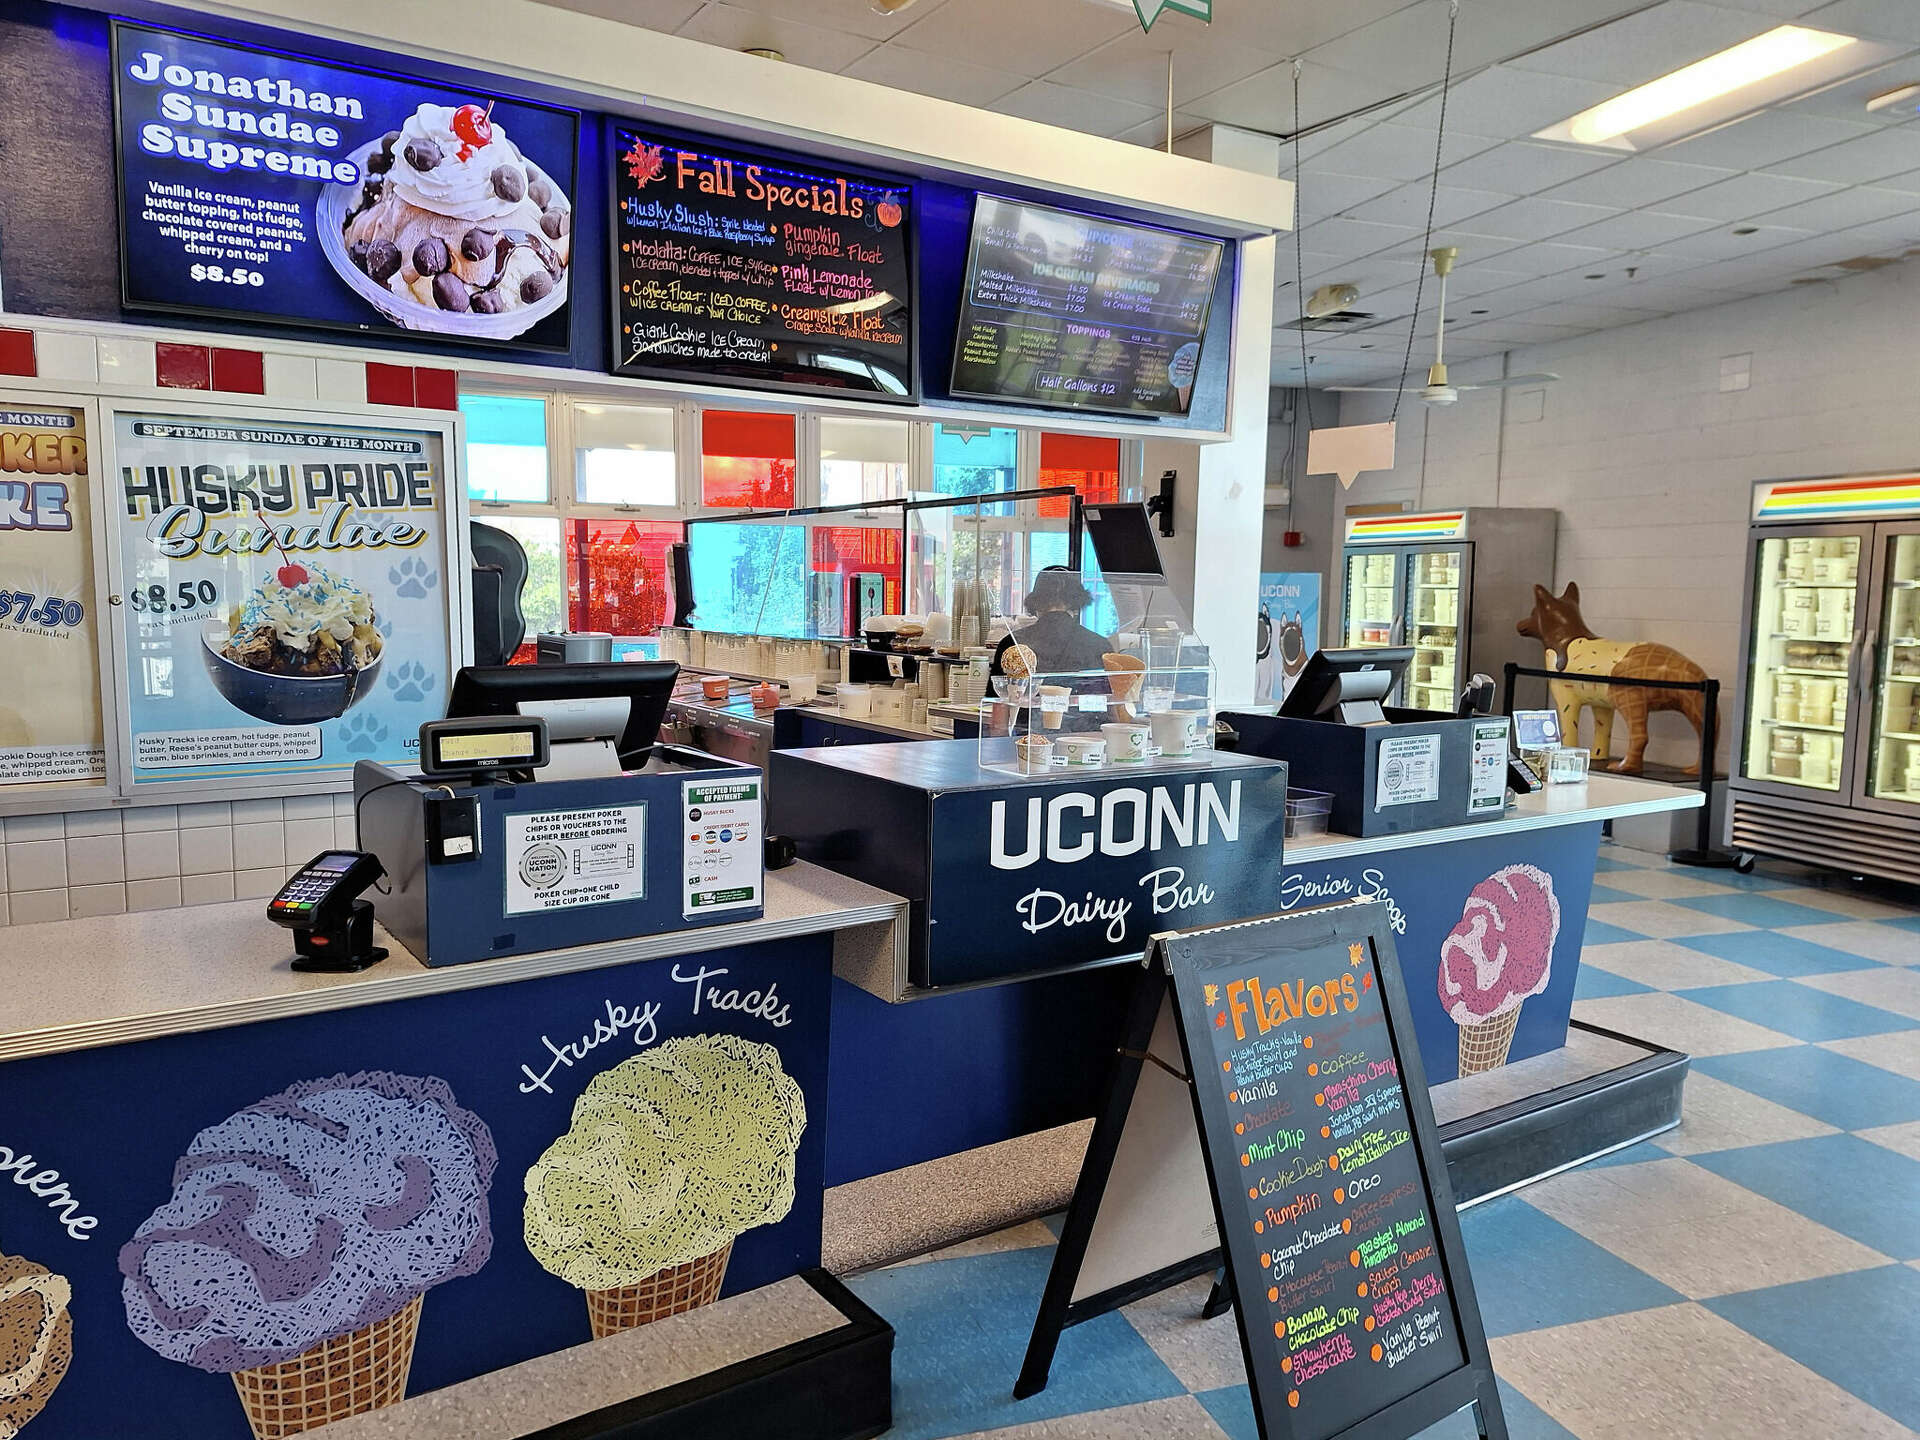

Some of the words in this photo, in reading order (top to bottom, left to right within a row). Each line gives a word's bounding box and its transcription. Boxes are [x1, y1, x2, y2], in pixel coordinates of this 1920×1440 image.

[130, 52, 364, 119] Jonathan
[161, 92, 339, 147] Sundae
[142, 124, 357, 183] Supreme
[149, 180, 192, 198] Vanilla
[214, 193, 256, 208] cream,
[257, 199, 300, 214] peanut
[676, 152, 736, 198] Fall
[746, 165, 864, 219] Specials
[145, 194, 186, 211] butter
[187, 201, 241, 220] topping,
[243, 208, 264, 222] hot
[265, 211, 304, 228] fudge,
[628, 196, 673, 223] Husky
[675, 203, 719, 228] Slush:
[142, 209, 203, 228] chocolate
[205, 218, 253, 234] covered
[256, 226, 307, 243] peanuts,
[783, 223, 840, 246] Pumpkin
[159, 225, 214, 242] whipped
[216, 233, 257, 249] cream,
[259, 239, 282, 251] and
[284, 243, 292, 252] a
[632, 239, 687, 260] Moolatta:
[184, 242, 224, 259] cherry
[226, 248, 242, 259] on
[245, 249, 269, 264] top!
[847, 243, 885, 264] Float
[190, 263, 265, 287] $8.50
[781, 264, 809, 282] Pink
[813, 268, 874, 289] Lemonade
[980, 269, 1014, 282] Milkshake
[632, 279, 669, 300] Coffee
[977, 290, 997, 300] Extra
[1000, 293, 1018, 303] Thick
[979, 280, 1003, 291] Malted
[1005, 285, 1039, 296] Milkshake
[632, 322, 668, 339] Giant
[670, 322, 706, 344] Cookie
[1066, 324, 1111, 339] TOPPINGS
[1040, 376, 1063, 389] Half
[1063, 378, 1098, 392] Gallons
[7, 413, 69, 427] MONTH
[143, 424, 238, 441] SEPTEMBER
[241, 430, 306, 445] SUNDAE
[307, 435, 328, 447] OF
[330, 436, 360, 449] THE
[362, 438, 414, 452] MONTH
[121, 463, 298, 516] HUSKY
[301, 462, 435, 510] PRIDE
[147, 500, 427, 559] Sundae
[130, 579, 217, 614] $8.50
[1260, 584, 1300, 597] UCONN
[0, 589, 84, 627] $7.50
[167, 611, 212, 625] included
[21, 624, 70, 640] included
[139, 737, 165, 746] Husky
[168, 736, 195, 744] Tracks
[241, 732, 255, 741] hot
[282, 731, 310, 739] peanut
[169, 743, 202, 752] Reese's
[203, 743, 232, 751] peanut
[234, 741, 258, 749] butter
[260, 741, 282, 749] cups,
[284, 739, 317, 747] whipped
[11, 759, 52, 770] whipped
[27, 751, 57, 762] Dough
[139, 755, 169, 763] cream,
[171, 752, 190, 760] blue
[191, 751, 232, 760] sprinkles,
[232, 750, 248, 758] and
[257, 748, 282, 757] cherry
[22, 769, 43, 778] chip
[45, 767, 76, 776] cookie
[78, 766, 89, 774] on
[696, 787, 728, 795] ACCEPTED
[526, 825, 548, 833] CHIPS
[563, 822, 601, 830] VOUCHERS
[530, 815, 561, 823] PLEASE
[562, 812, 595, 820] PRESENT
[990, 779, 1241, 871] UCONN
[560, 831, 589, 839] BEFORE
[591, 827, 628, 836] ORDERING
[591, 843, 618, 851] UCONN
[529, 858, 557, 866] UCONN
[529, 864, 557, 872] NATION
[534, 891, 560, 899] POKER
[599, 883, 620, 892] CHILD
[545, 899, 560, 907] SIZE
[591, 893, 610, 901] CONE
[1280, 874, 1354, 910] Senior
[1015, 887, 1134, 943] Dairy
[1137, 866, 1216, 916] Bar
[1225, 971, 1360, 1042] Flavors
[518, 999, 662, 1095] Husky
[670, 963, 792, 1028] Tracks
[1367, 1057, 1398, 1080] Cherry
[1237, 1079, 1279, 1106] Vanilla
[1328, 1103, 1364, 1128] Jonathan
[1248, 1135, 1276, 1164] Mint
[1275, 1128, 1306, 1153] Chip
[1336, 1138, 1363, 1161] Dairy
[1340, 1151, 1368, 1175] Lemon
[1391, 1129, 1410, 1146] Ice
[1259, 1168, 1295, 1197] Cookie
[1293, 1156, 1328, 1183] Dough
[1348, 1174, 1381, 1199] Oreo
[1265, 1193, 1322, 1229] Pumpkin
[1395, 1209, 1426, 1239] Almond
[1273, 1260, 1295, 1281] Chip
[1368, 1260, 1399, 1285] Salted
[1371, 1277, 1402, 1300] Crunch
[1287, 1305, 1328, 1335] Banana
[1336, 1306, 1360, 1327] Chip
[1381, 1320, 1412, 1351] Vanilla
[1414, 1306, 1440, 1332] Peanut
[1419, 1322, 1444, 1347] Swirl
